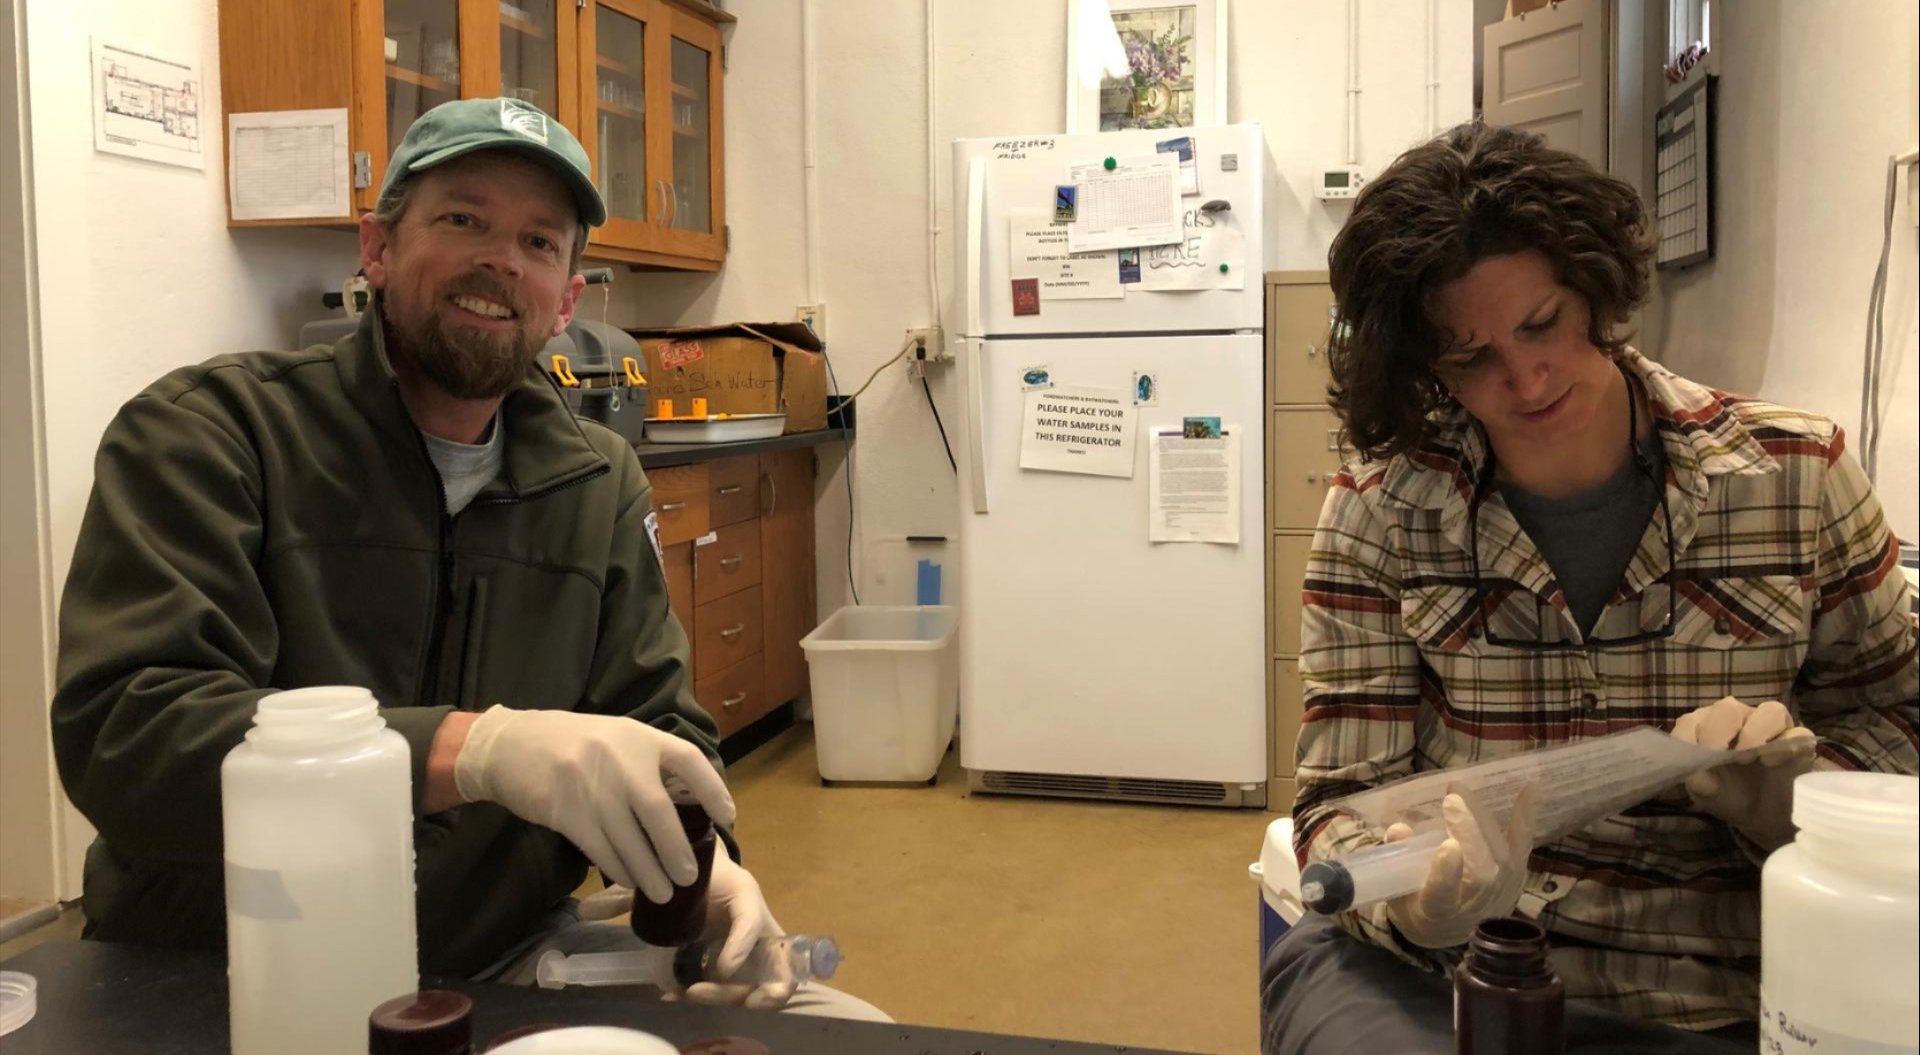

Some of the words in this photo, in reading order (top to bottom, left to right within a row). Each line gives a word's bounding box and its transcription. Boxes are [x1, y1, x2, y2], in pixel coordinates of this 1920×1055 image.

[1183, 209, 1216, 228] CKS
[728, 371, 775, 390] Water
[1037, 403, 1068, 414] PLEASE
[1070, 406, 1097, 416] PLACE
[1098, 408, 1124, 418] YOUR
[1037, 418, 1068, 428] WATER
[1070, 420, 1110, 432] SAMPLES
[1111, 424, 1122, 433] IN
[1035, 431, 1054, 442] THIS
[1056, 434, 1122, 447] REFRIGERATOR
